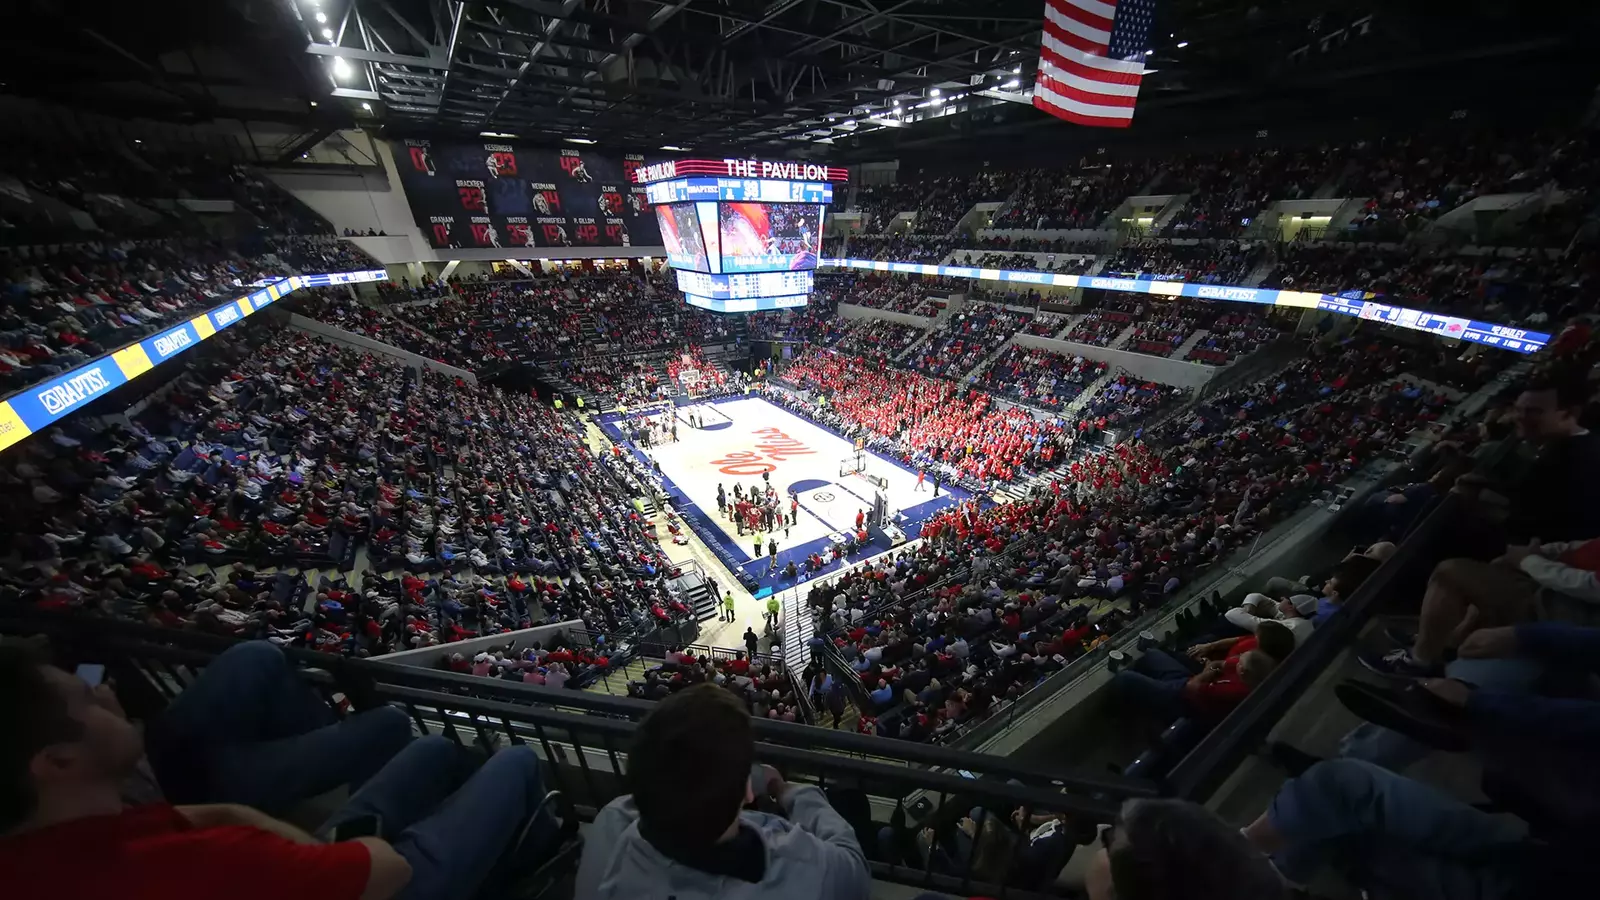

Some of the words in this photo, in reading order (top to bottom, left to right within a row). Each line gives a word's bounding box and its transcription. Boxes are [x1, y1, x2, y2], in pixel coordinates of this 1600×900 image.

[403, 139, 431, 148] PHILLIPS
[484, 143, 514, 152] KESSINGER
[635, 166, 649, 183] THE
[647, 160, 677, 181] PAVILION
[724, 158, 758, 177] THE
[762, 161, 828, 180] PAVILION
[531, 182, 556, 190] NEUMANN
[506, 216, 528, 224] WATERS
[1211, 286, 1258, 300] BAPTIST
[1500, 327, 1527, 338] BAILEY
[56, 367, 111, 408] BAPTIST
[709, 450, 777, 475] Ole
[751, 426, 818, 461] Miss
